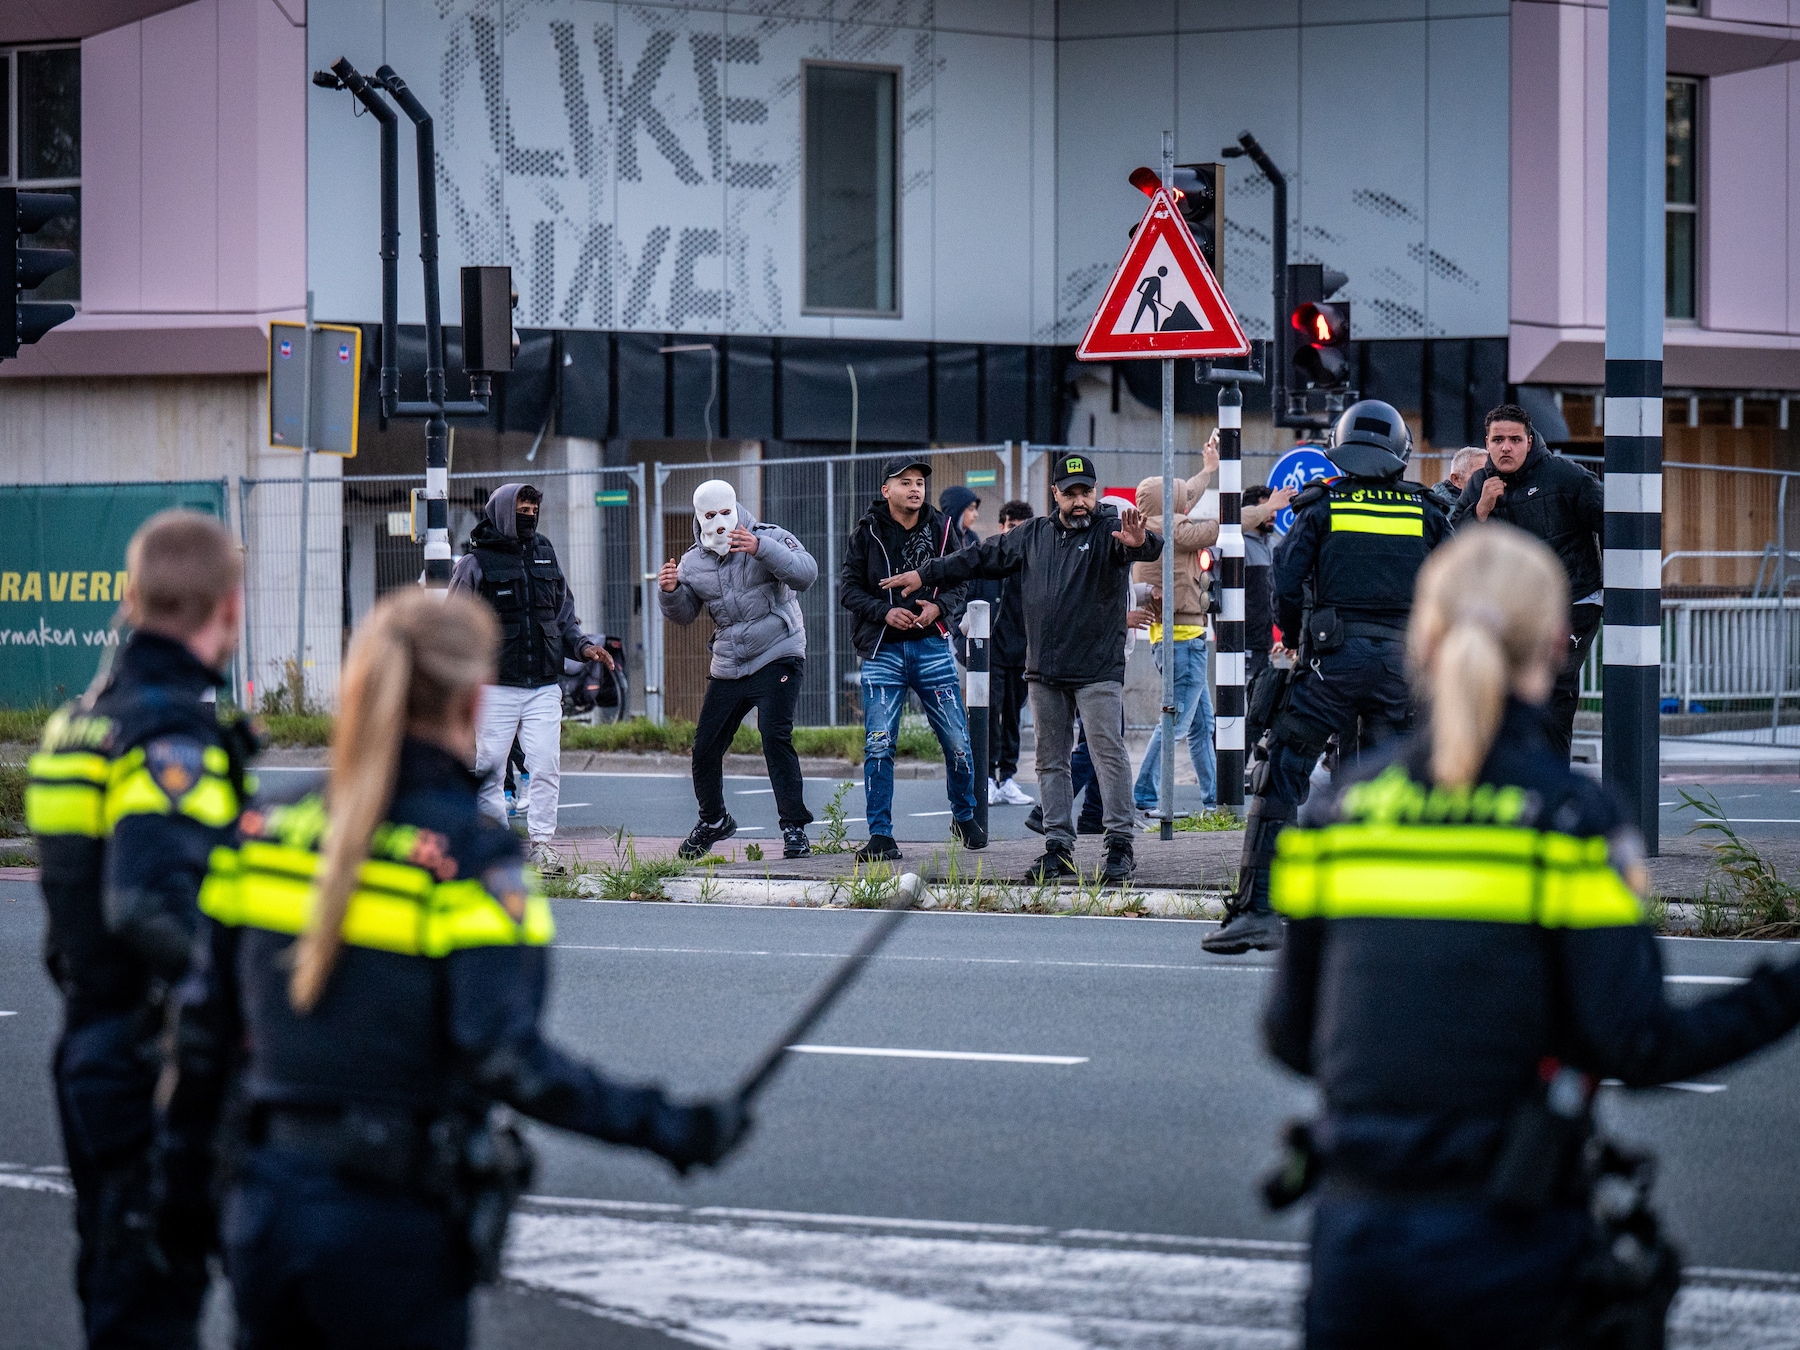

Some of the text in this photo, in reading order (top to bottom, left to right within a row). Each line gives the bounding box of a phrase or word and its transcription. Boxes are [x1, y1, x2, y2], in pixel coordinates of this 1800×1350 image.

[470, 16, 779, 188] LIKE
[0, 616, 77, 647] rmaken
[82, 628, 120, 647] van
